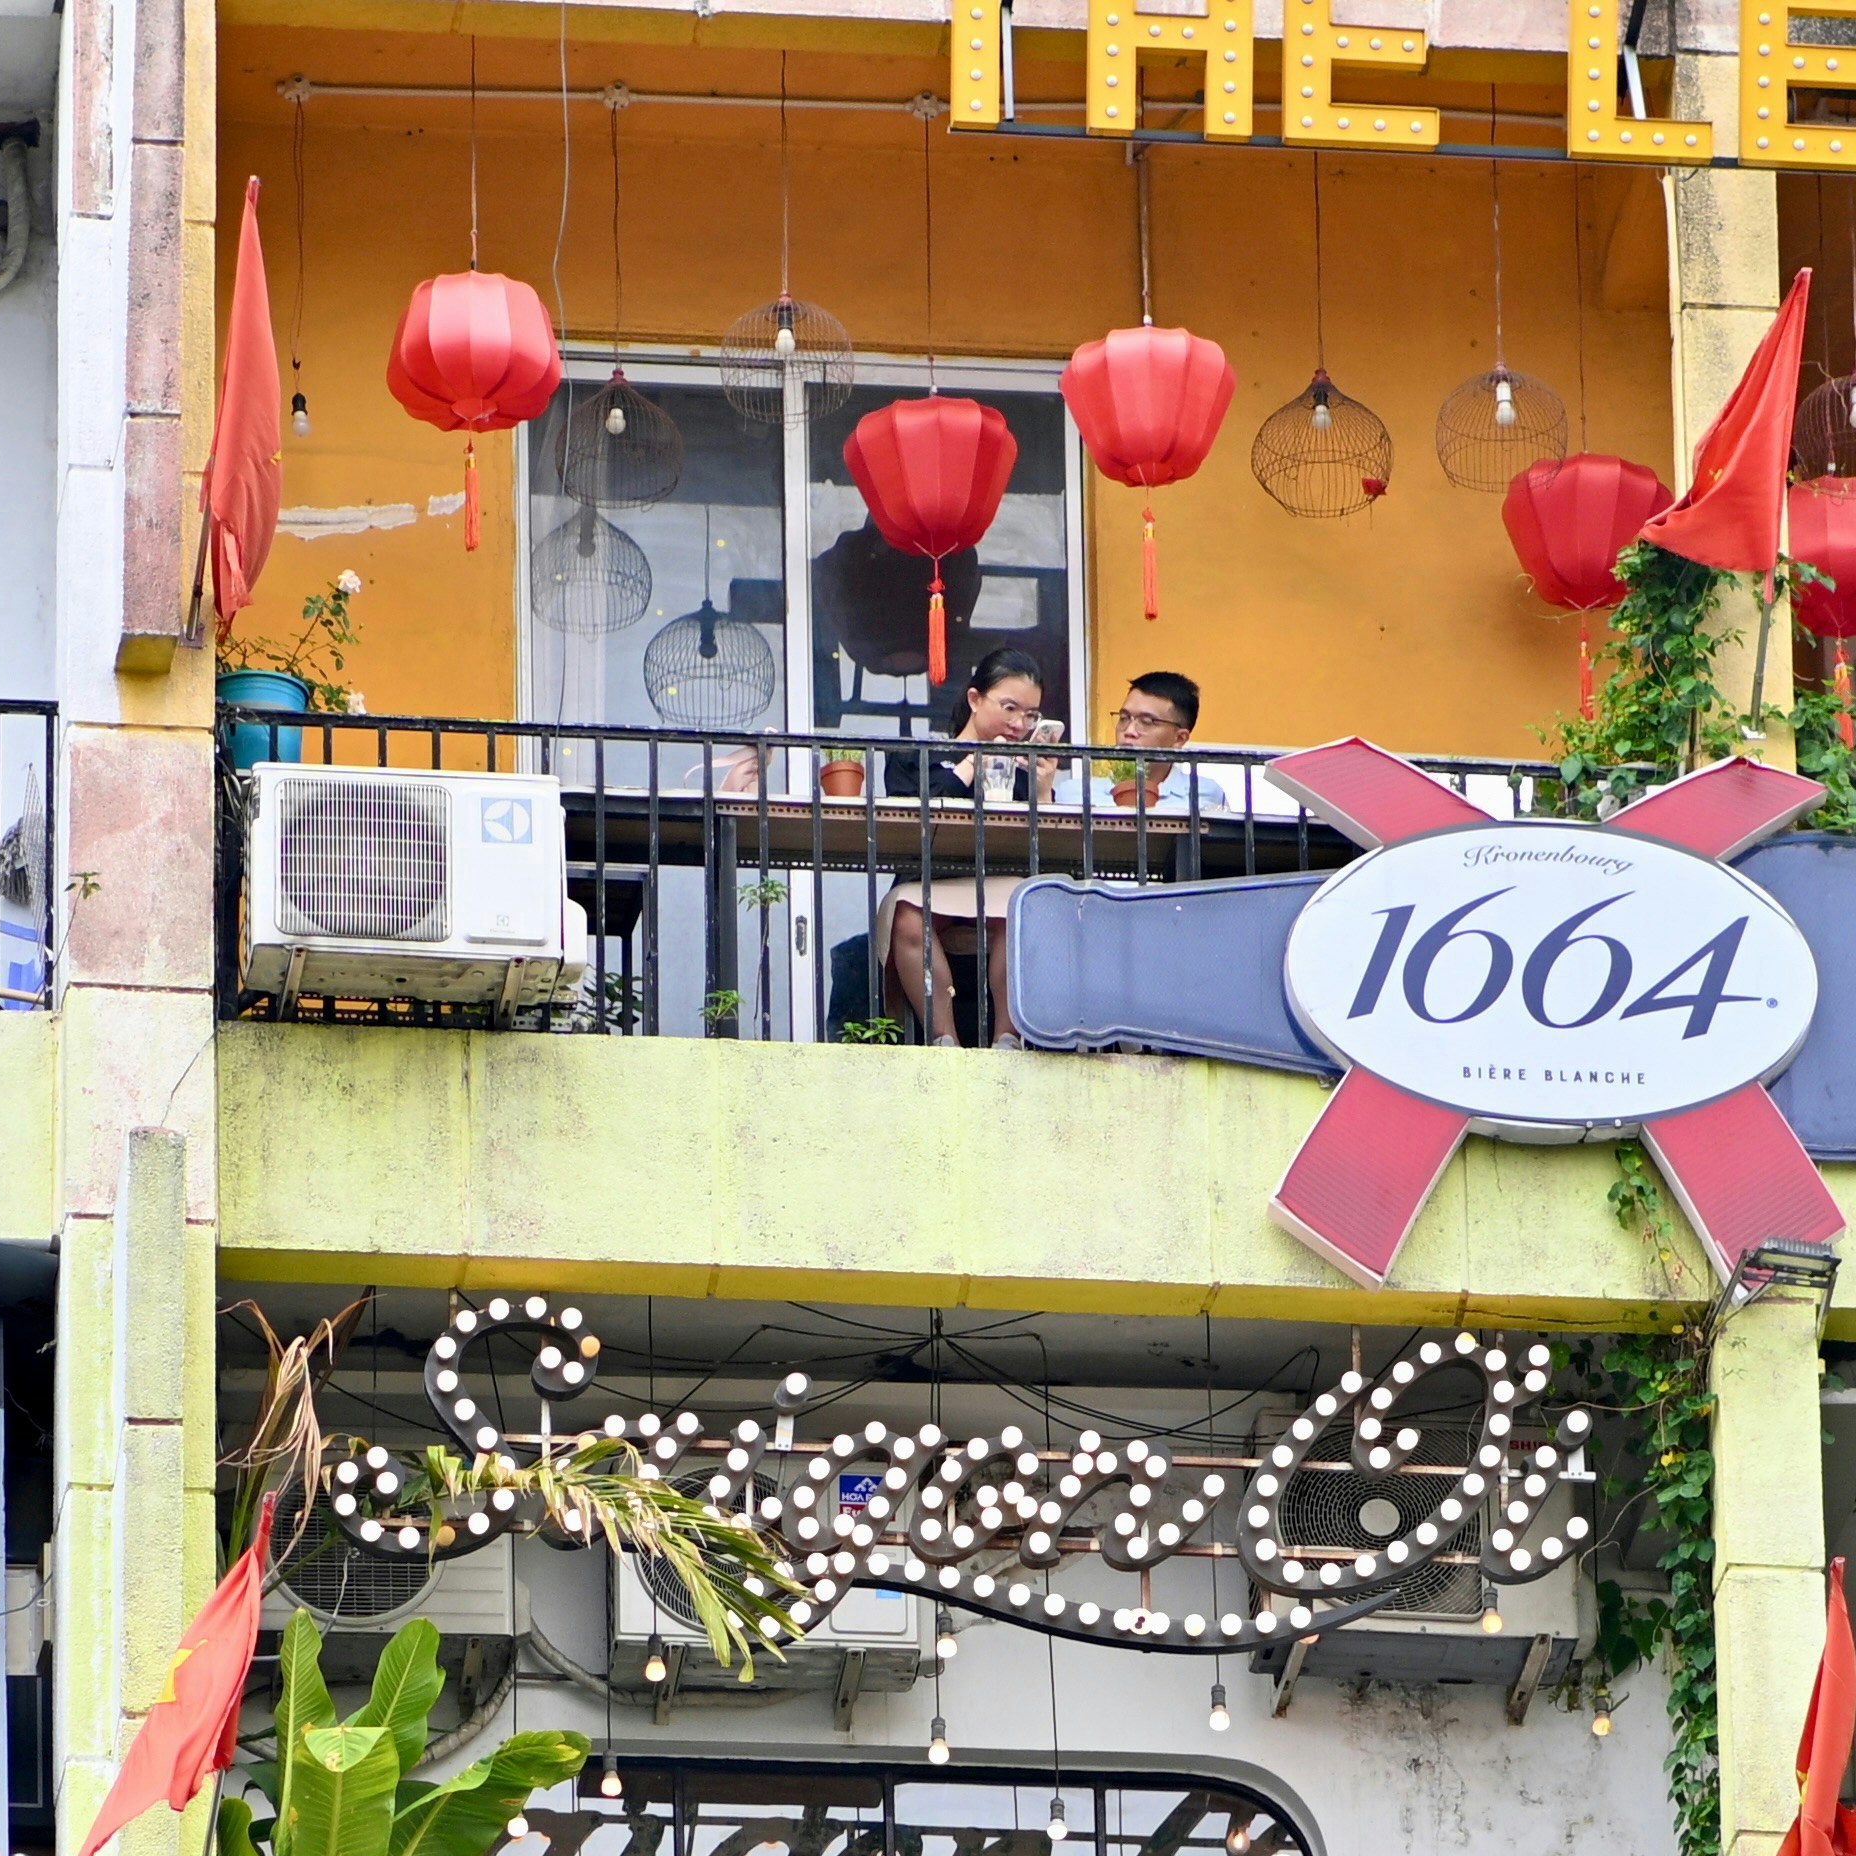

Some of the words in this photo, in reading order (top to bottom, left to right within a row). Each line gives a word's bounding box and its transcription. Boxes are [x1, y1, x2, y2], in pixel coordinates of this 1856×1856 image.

[1463, 844, 1635, 877] Kronenbourg
[1345, 885, 1763, 1041] 1664
[1463, 1064, 1528, 1082] BIÈRE
[1544, 1068, 1646, 1086] BLANCHE
[329, 1292, 1229, 1658] Saigon
